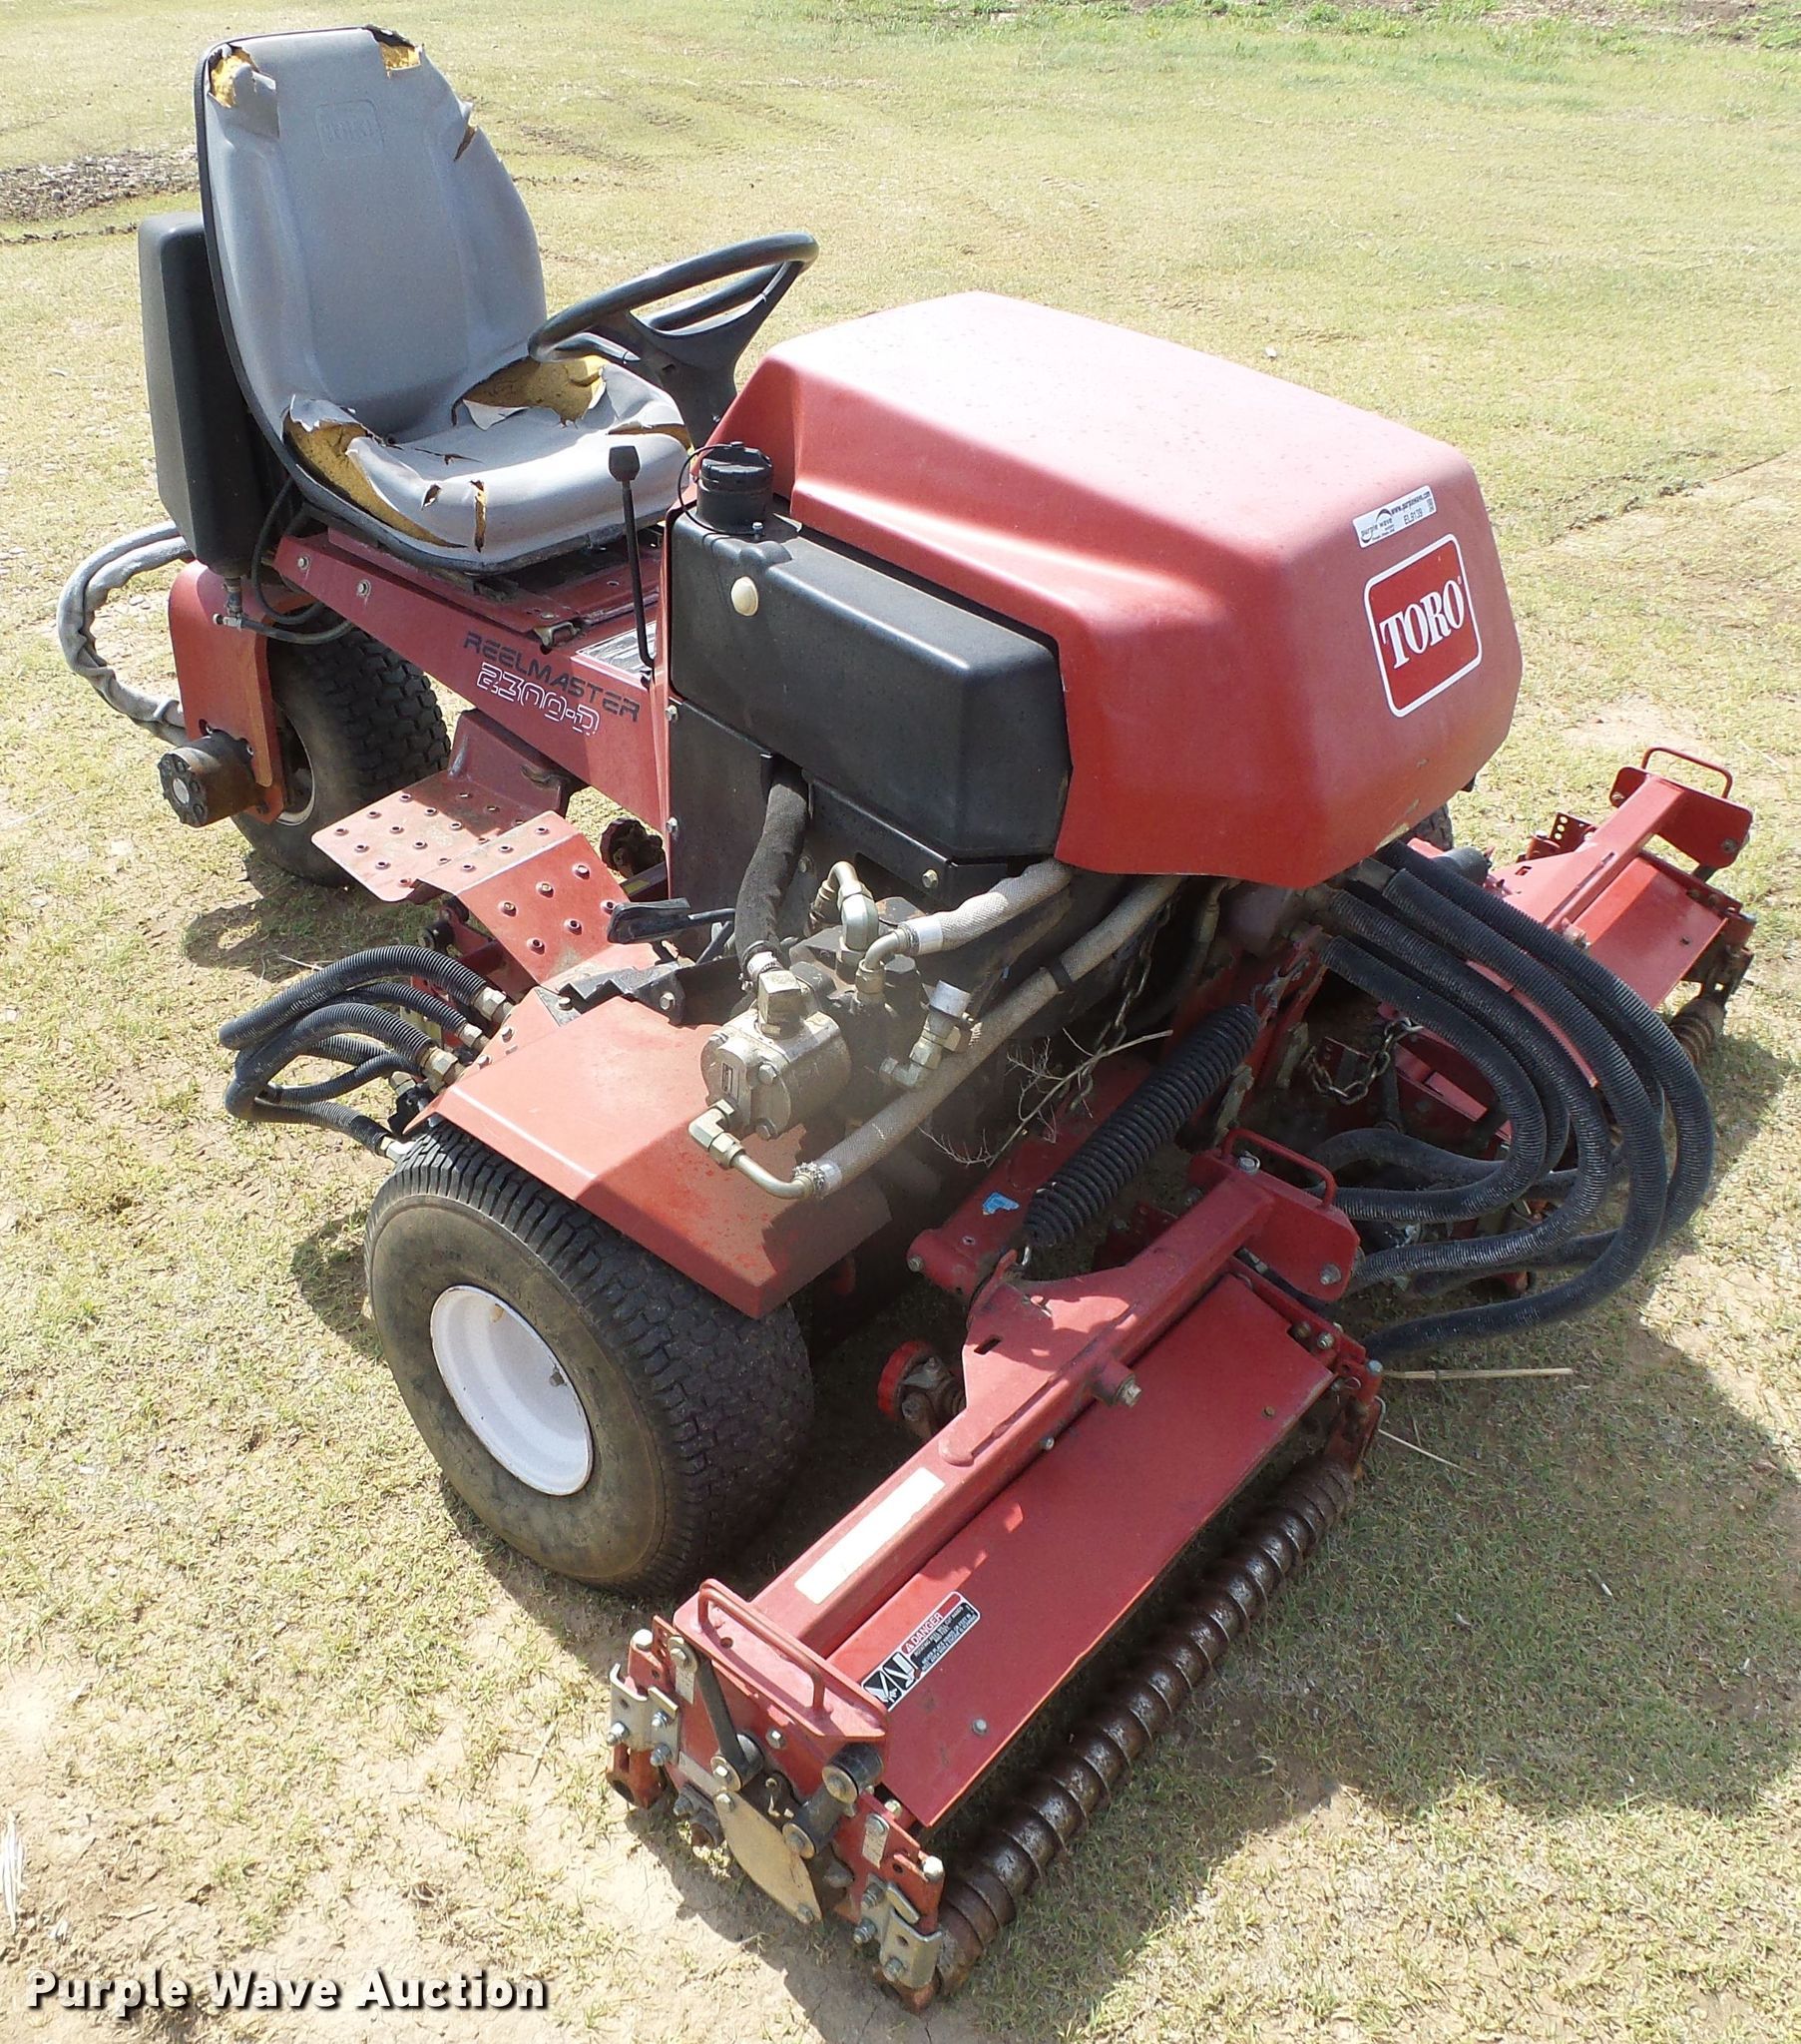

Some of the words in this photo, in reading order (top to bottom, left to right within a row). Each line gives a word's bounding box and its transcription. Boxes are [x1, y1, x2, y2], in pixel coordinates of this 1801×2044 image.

[1379, 580, 1465, 670] TORO
[464, 631, 641, 722] REELMASTER
[477, 662, 600, 737] 2300-D
[911, 1612, 944, 1645] DANGER
